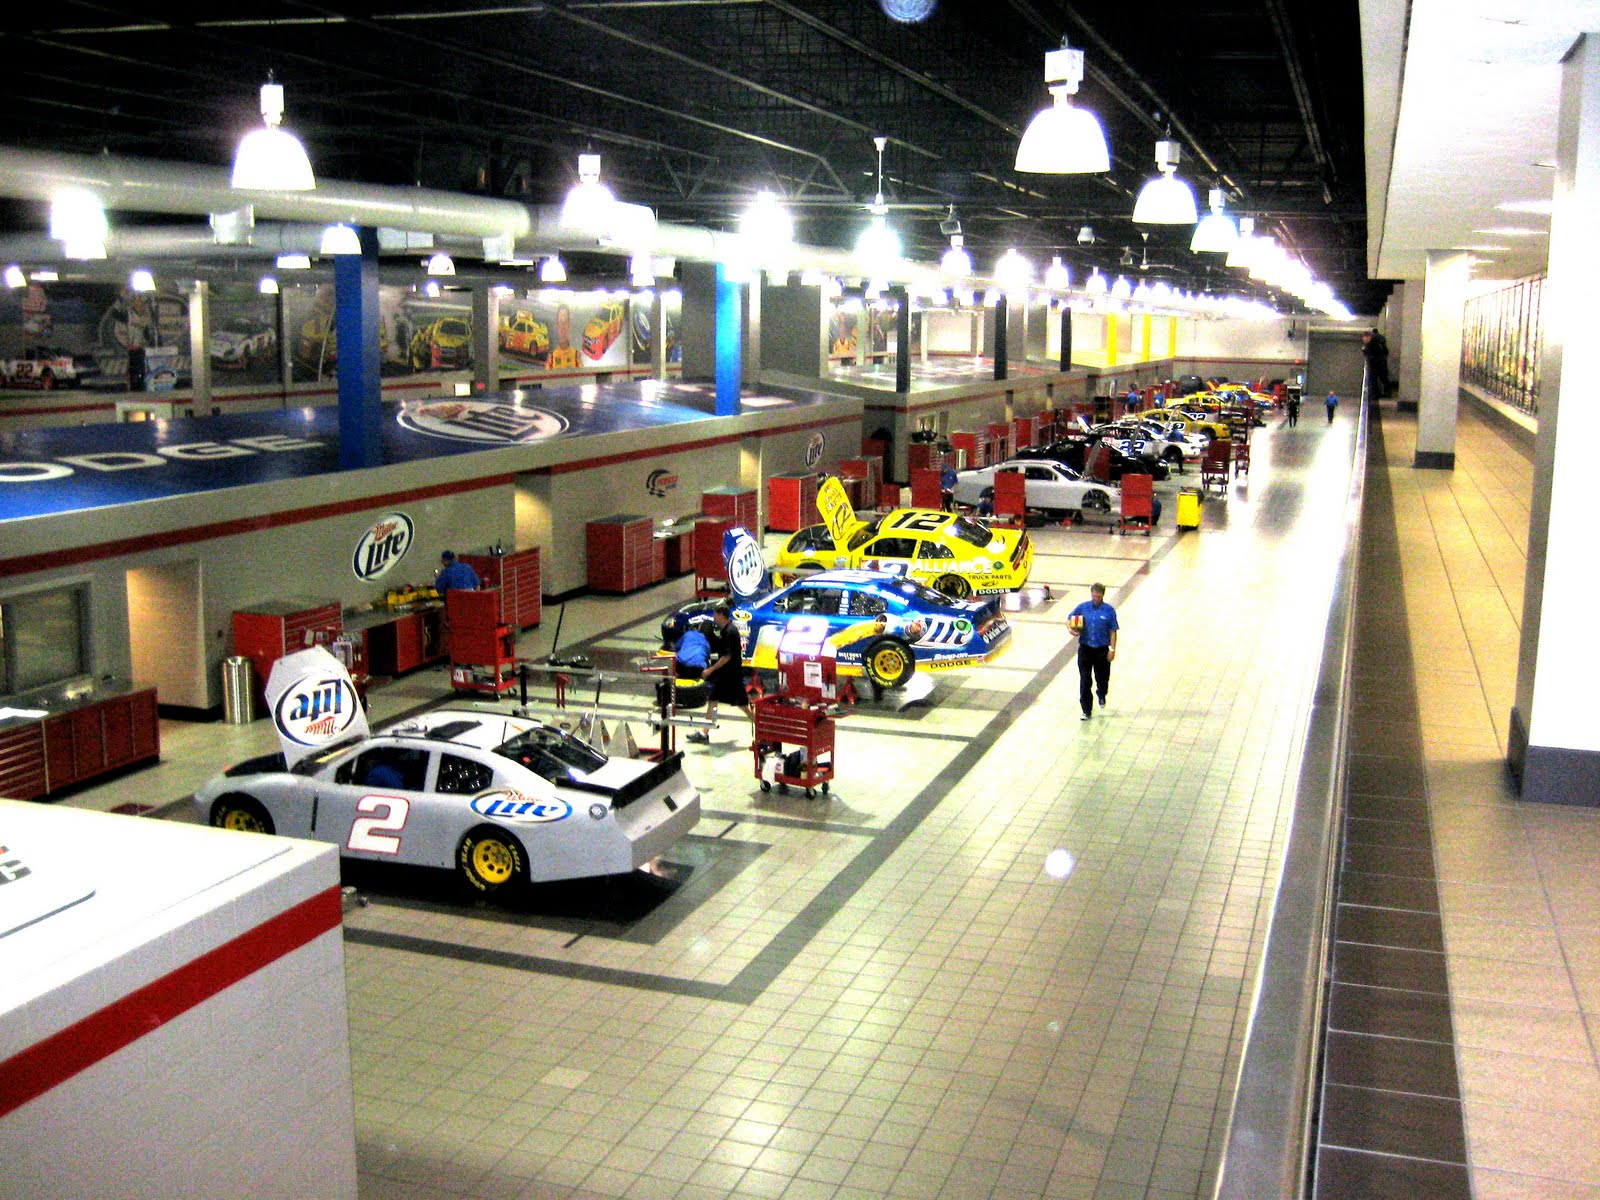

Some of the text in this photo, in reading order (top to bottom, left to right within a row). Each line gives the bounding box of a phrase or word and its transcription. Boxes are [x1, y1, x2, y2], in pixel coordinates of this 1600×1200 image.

[890, 511, 951, 531] 12
[364, 531, 406, 576] Lite
[912, 557, 993, 575] ALLIANCE
[978, 588, 1012, 596] DODGE
[930, 660, 972, 669] DODGE
[290, 678, 342, 722] Lite
[483, 799, 559, 818] Lite
[346, 794, 411, 856] 2
